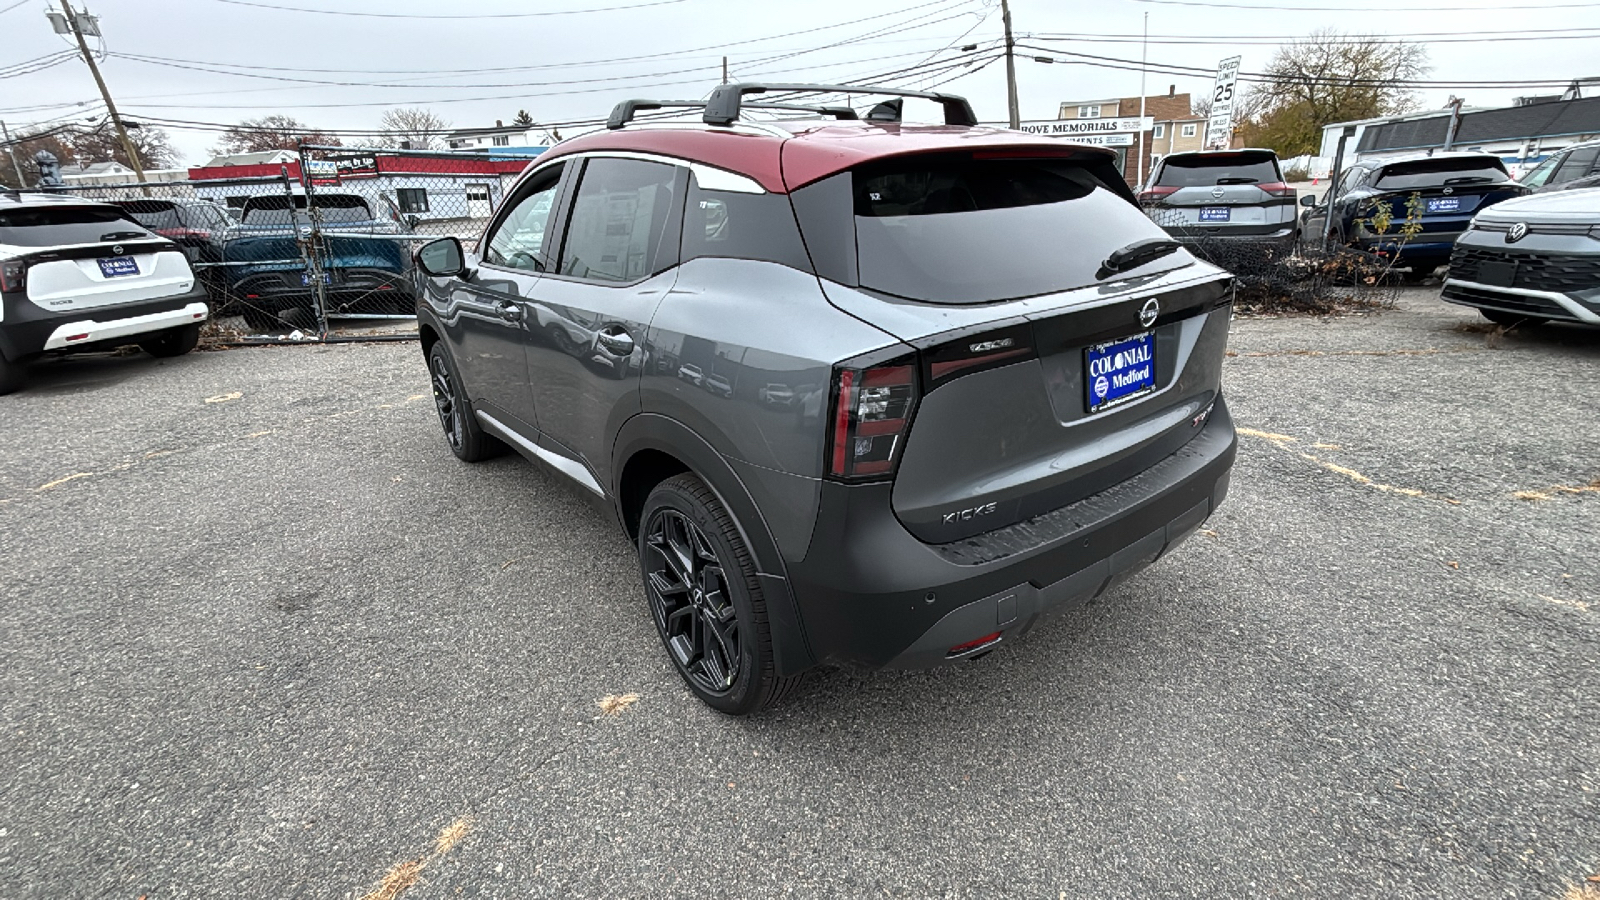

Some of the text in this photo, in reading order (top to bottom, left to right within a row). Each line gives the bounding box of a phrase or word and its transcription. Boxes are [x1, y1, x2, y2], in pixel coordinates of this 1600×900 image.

[1219, 61, 1239, 70] SPEED
[1218, 71, 1235, 82] LIMIT
[1214, 83, 1234, 102] 25
[1052, 122, 1118, 133] MEMORIALS
[1090, 344, 1152, 377] COLONIAL
[1112, 365, 1149, 389] Medford
[942, 501, 998, 526] KICKS
